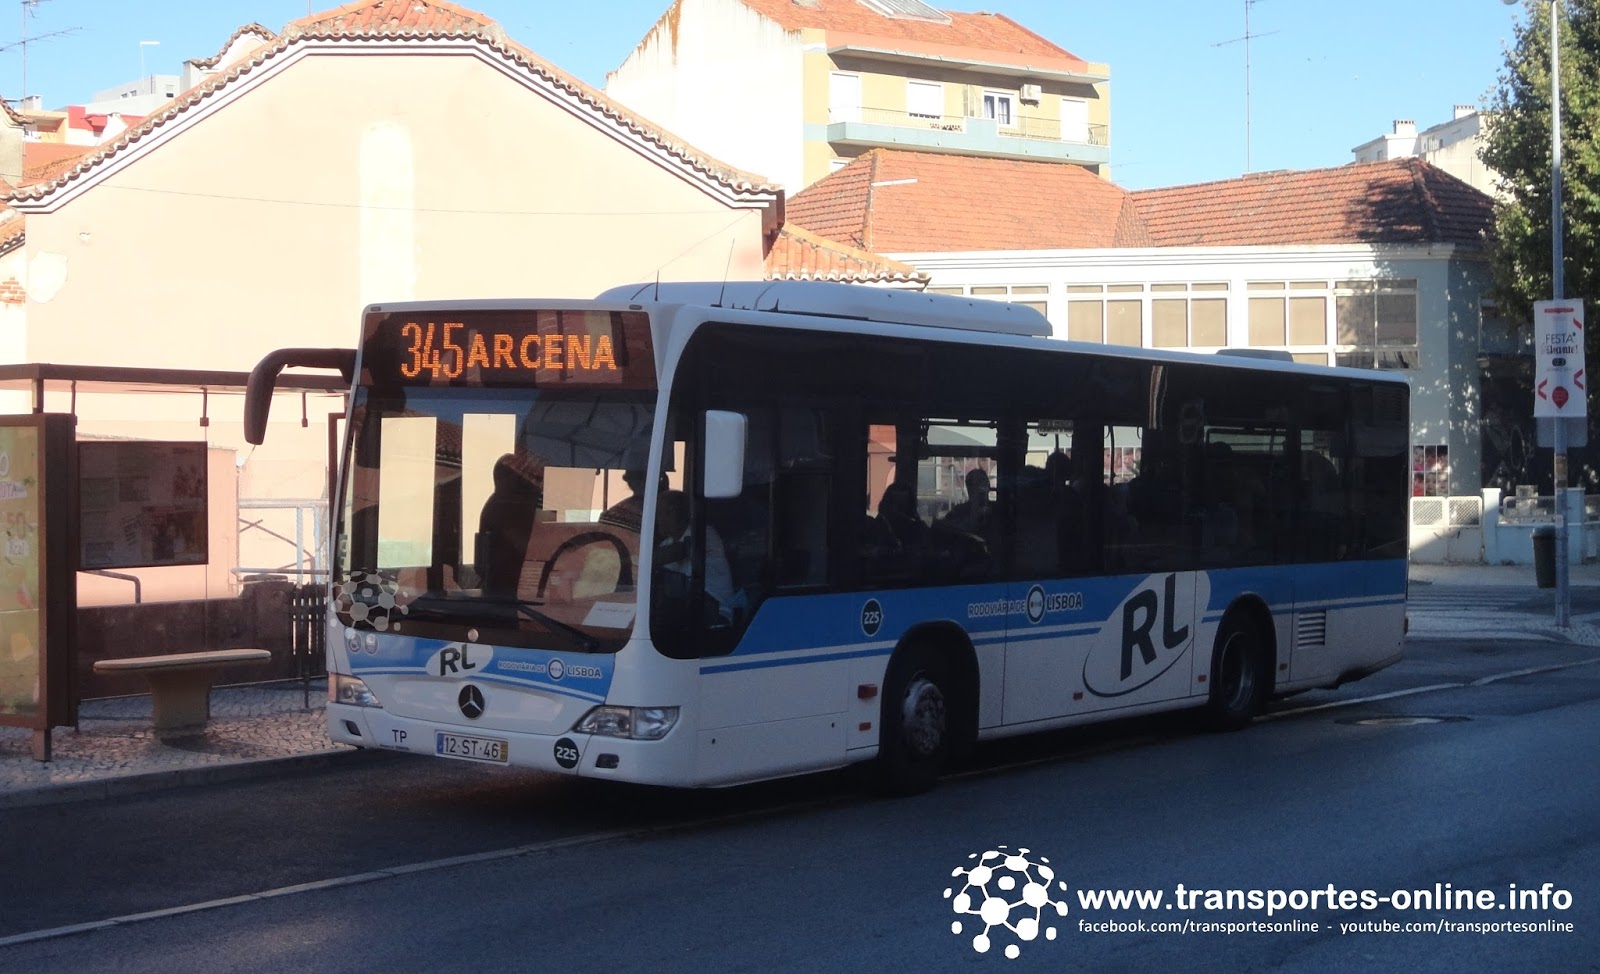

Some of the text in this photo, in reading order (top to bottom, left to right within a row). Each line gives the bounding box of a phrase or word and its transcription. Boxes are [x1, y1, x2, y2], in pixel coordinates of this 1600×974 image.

[1545, 333, 1574, 344] FESTA
[401, 322, 617, 378] 345 ARCENA
[968, 592, 1083, 618] RODOVIÁRIA DE LISBOA
[863, 610, 881, 625] 225
[1119, 572, 1189, 682] RL
[439, 643, 477, 677] RL
[536, 664, 546, 672] DE
[567, 666, 601, 678] LISBOA
[391, 728, 408, 744] TP
[555, 745, 578, 761] 225
